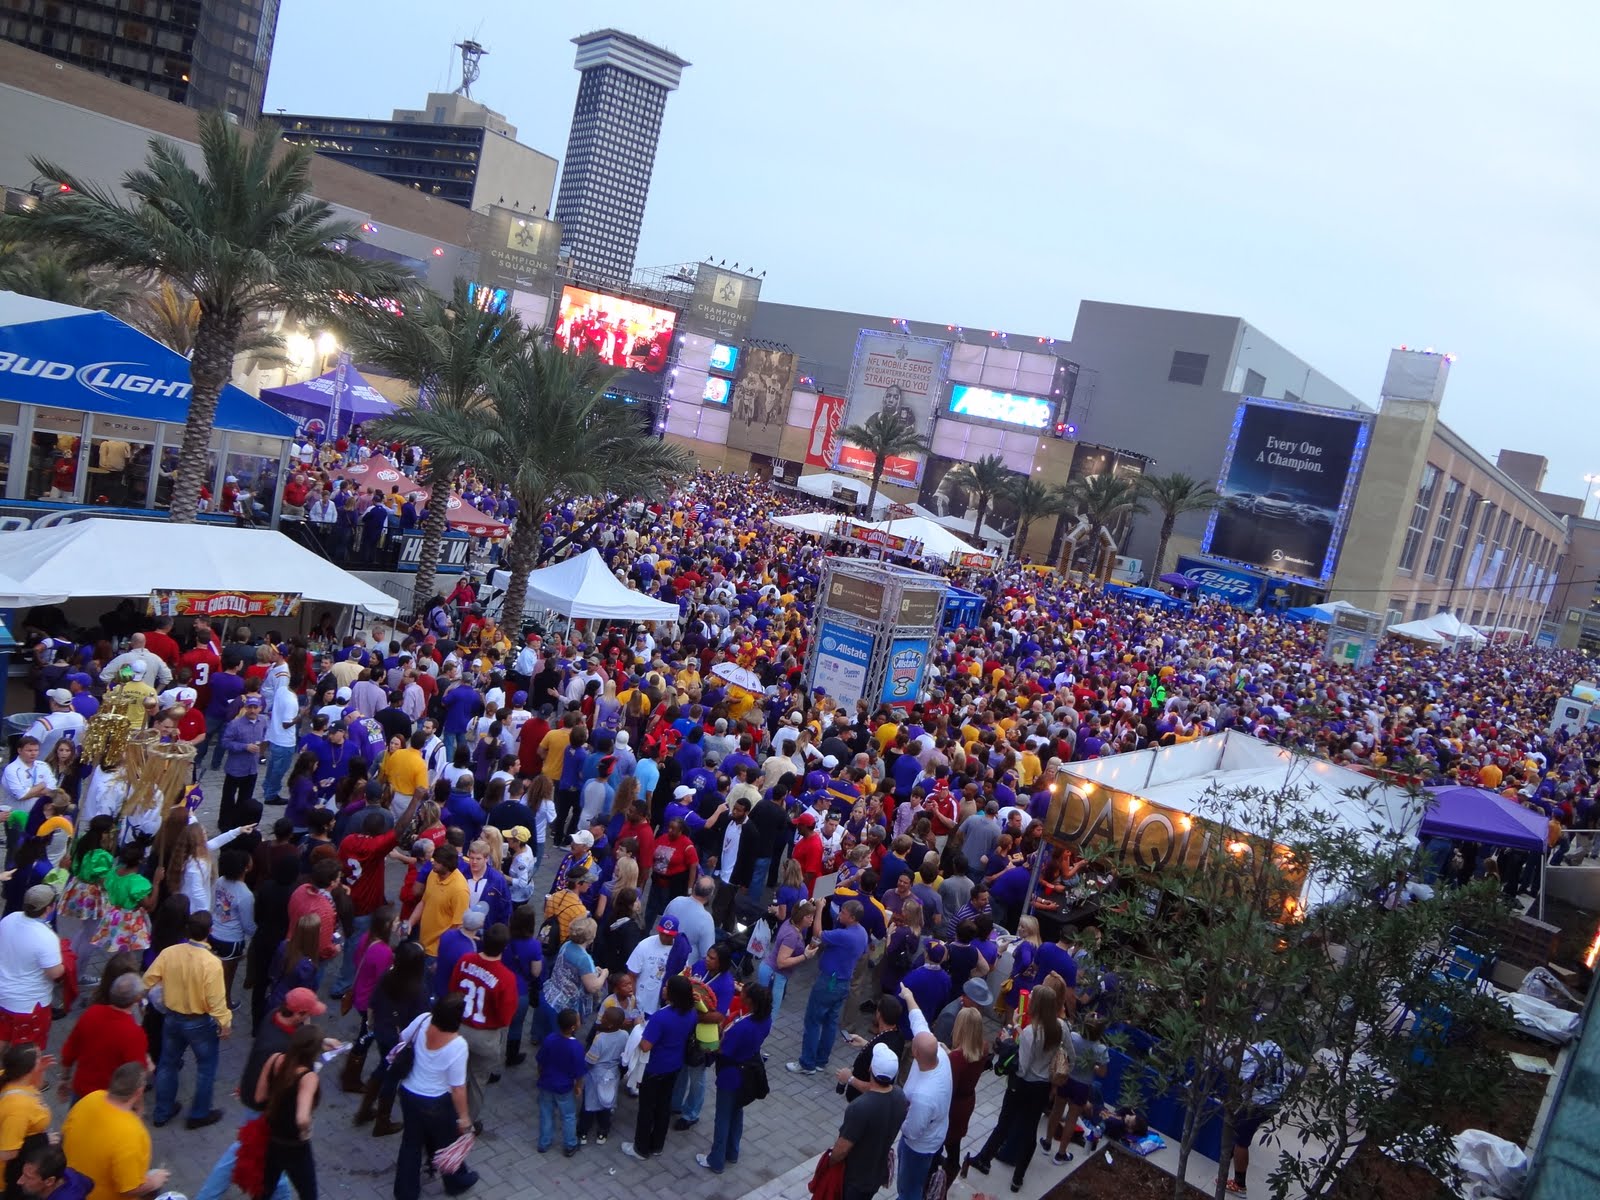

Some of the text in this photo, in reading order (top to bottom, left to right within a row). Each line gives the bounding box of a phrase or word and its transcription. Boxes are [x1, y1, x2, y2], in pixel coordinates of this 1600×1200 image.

[491, 249, 548, 270] CHAMPIONS
[498, 260, 538, 275] SQUARE
[698, 304, 747, 322] CHAMPIONS
[704, 313, 738, 327] SQUARE
[0, 351, 194, 400] BUD LIGHT
[867, 357, 933, 375] NFL MOBILE SENDS
[864, 373, 929, 392] STRAIGHT TO YOU
[1266, 435, 1323, 457] Every One
[1256, 450, 1324, 473] A Champion.
[401, 537, 449, 562] HE
[1200, 570, 1251, 589] BUD
[208, 595, 247, 613] COCKTAIL
[835, 643, 868, 660] Allstate
[195, 662, 210, 686] 3
[346, 857, 363, 886] 3
